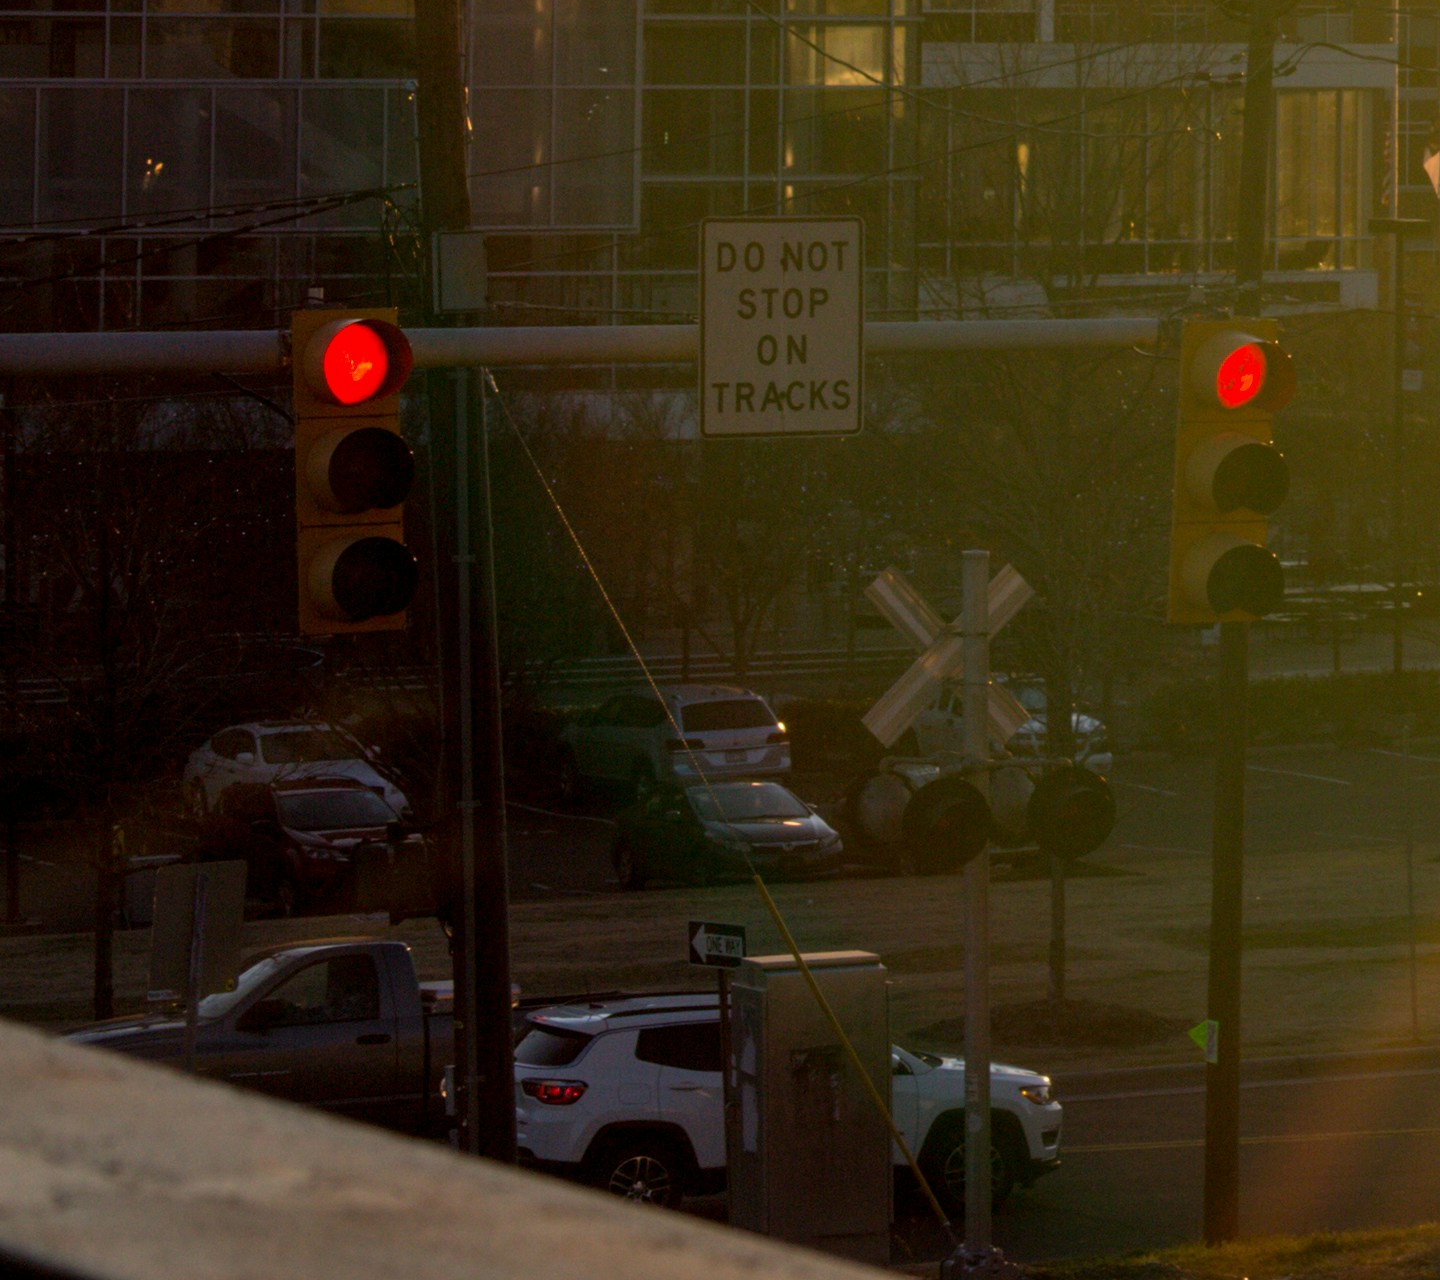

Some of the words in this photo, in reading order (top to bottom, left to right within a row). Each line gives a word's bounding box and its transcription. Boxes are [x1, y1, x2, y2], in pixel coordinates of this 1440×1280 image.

[717, 241, 765, 273] DO
[782, 241, 849, 272] NOT
[737, 287, 830, 320] STOP
[757, 334, 807, 366] ON
[711, 379, 851, 413] TRACKS
[706, 935, 723, 953] ONE
[725, 938, 741, 955] WAY
